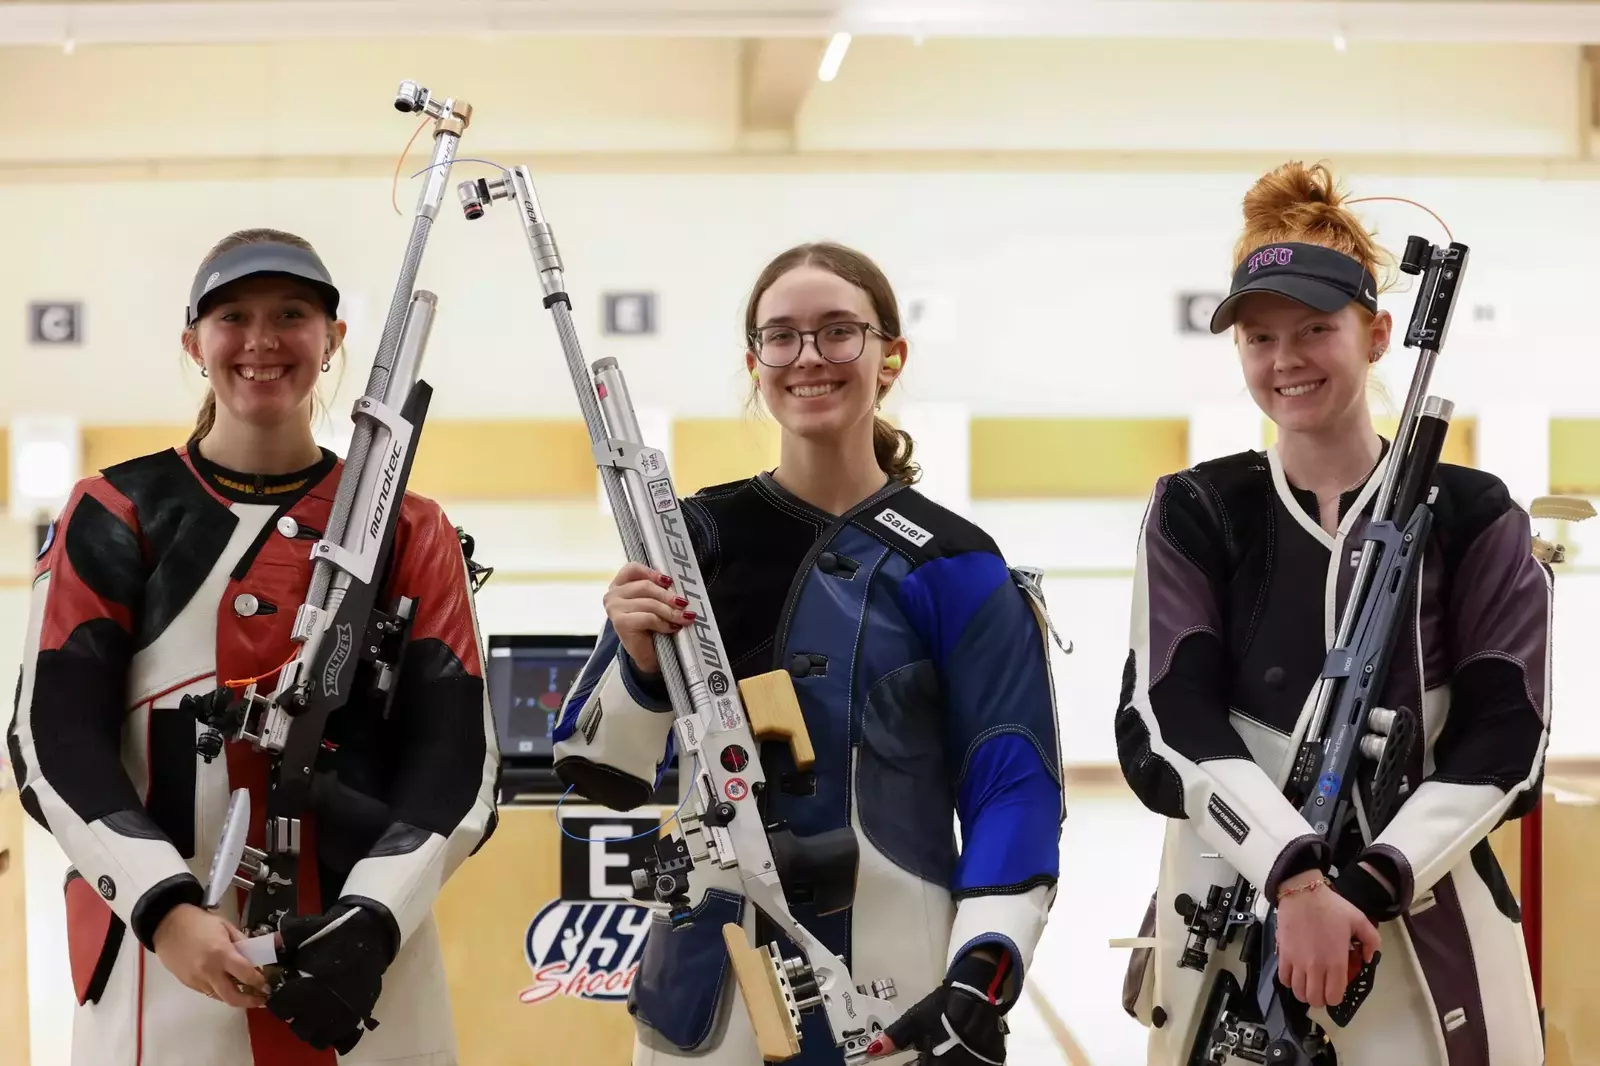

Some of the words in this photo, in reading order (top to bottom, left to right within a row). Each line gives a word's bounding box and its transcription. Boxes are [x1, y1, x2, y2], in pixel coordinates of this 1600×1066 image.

[1248, 247, 1293, 274] TCU
[369, 439, 403, 540] monotec
[881, 512, 926, 541] Sauer
[660, 513, 723, 670] WALTHER
[325, 632, 351, 687] WALTHER
[589, 824, 634, 899] E
[540, 903, 650, 974] US
